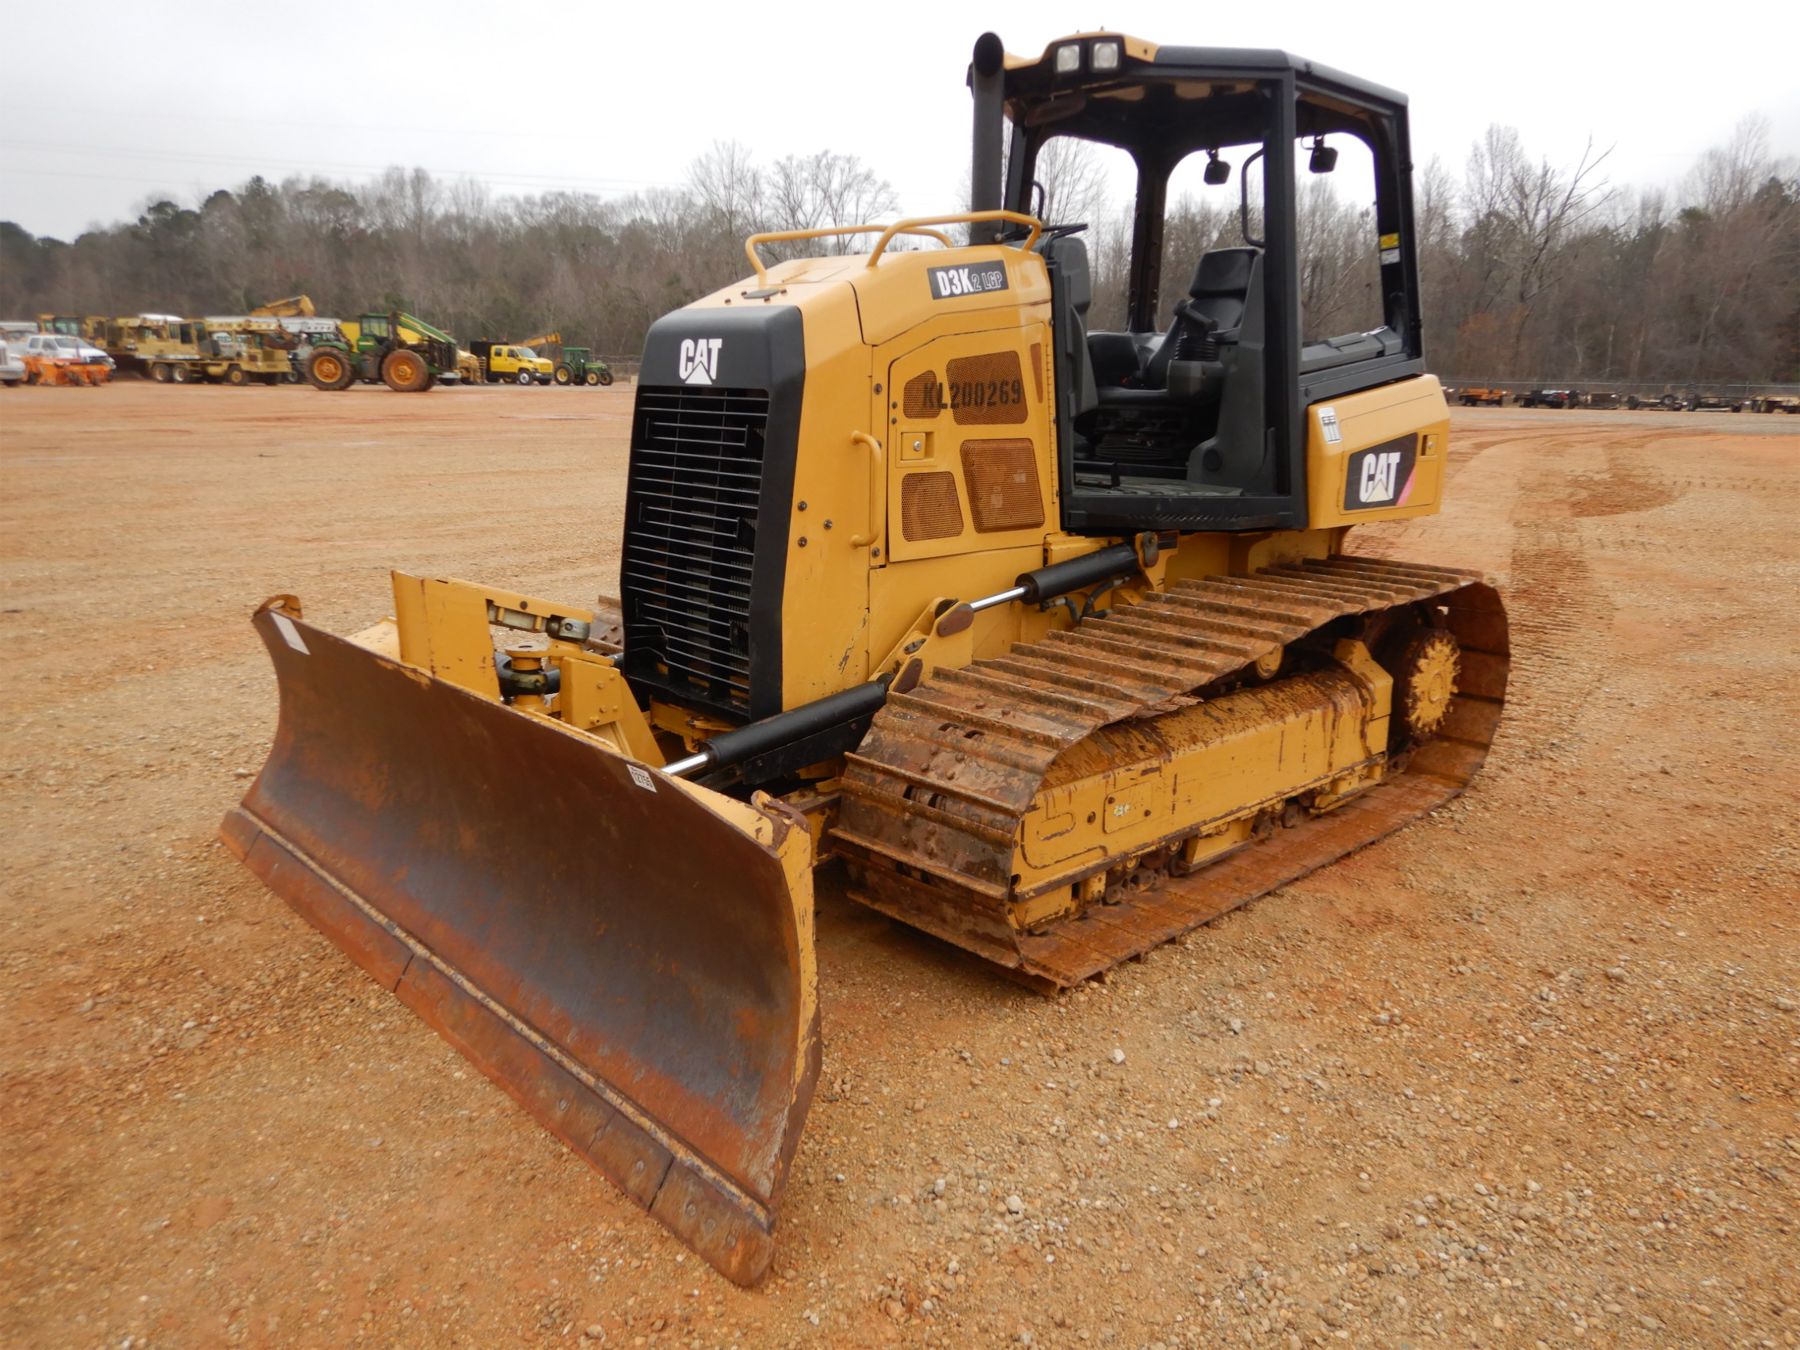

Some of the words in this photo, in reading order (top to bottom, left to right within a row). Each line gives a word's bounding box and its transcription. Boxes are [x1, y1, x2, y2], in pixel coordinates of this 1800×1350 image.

[981, 271, 1003, 290] LGP
[678, 338, 723, 384] CAT
[924, 379, 1021, 409] KL200269
[1359, 452, 1401, 503] CAT
